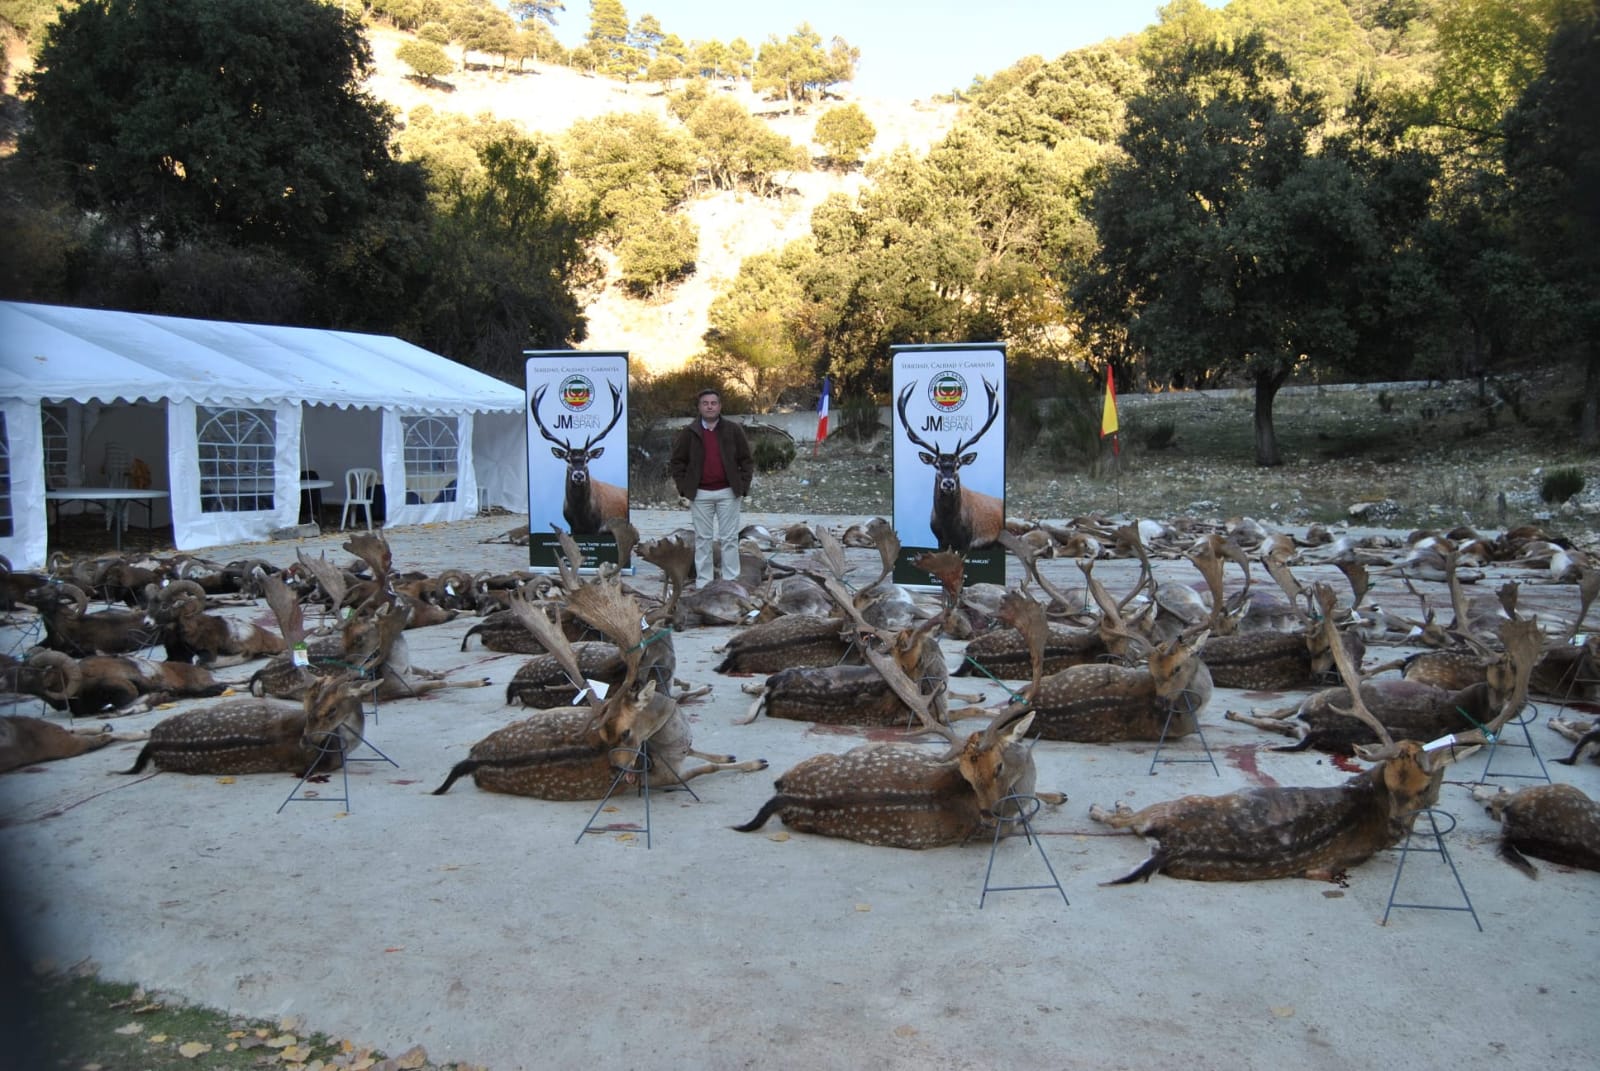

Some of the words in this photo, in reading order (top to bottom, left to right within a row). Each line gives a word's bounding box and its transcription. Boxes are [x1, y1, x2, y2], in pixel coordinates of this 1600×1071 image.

[553, 414, 573, 429] JM
[573, 420, 601, 429] SPAIN
[921, 415, 943, 431] JM
[943, 421, 973, 432] SPAIN
